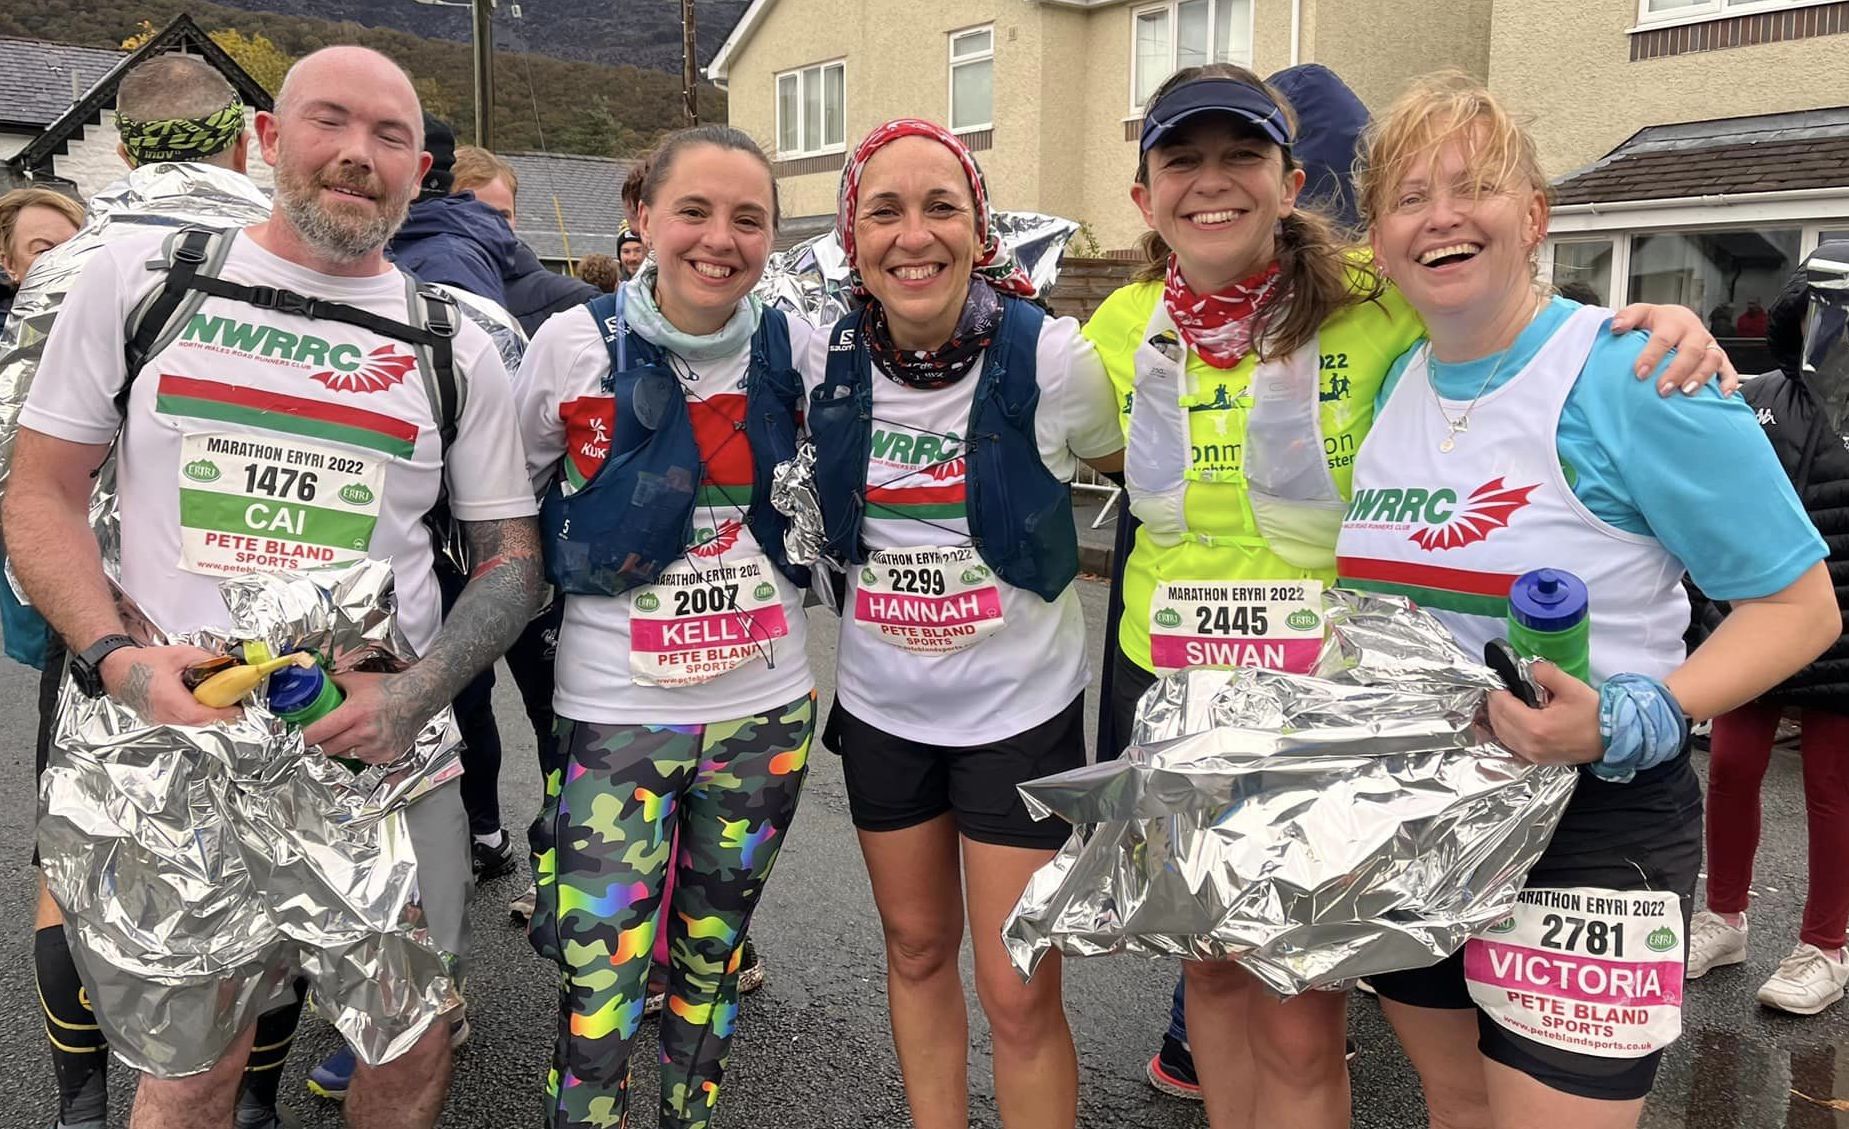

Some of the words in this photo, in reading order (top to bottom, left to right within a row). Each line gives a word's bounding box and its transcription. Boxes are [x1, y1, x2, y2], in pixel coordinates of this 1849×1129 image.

[181, 314, 361, 372] NWRRC
[205, 344, 229, 354] WALES
[232, 350, 253, 359] ROAD
[254, 355, 290, 367] RUNNERS
[291, 362, 312, 370] CLUB
[207, 438, 283, 462] MARATHON
[286, 449, 325, 469] ERYRI
[329, 457, 364, 475] 2022
[872, 430, 960, 464] WRRC
[245, 463, 318, 501] 1476
[244, 503, 306, 535] CAI
[205, 532, 258, 551] PETE
[265, 540, 334, 561] BLAND
[235, 552, 298, 569] SPORTS
[874, 551, 913, 565] ATHON
[889, 568, 945, 596] 2299
[1168, 586, 1228, 601] MARATHON
[1232, 587, 1266, 601] ERYRI
[1270, 587, 1305, 601] 2022
[674, 584, 739, 616] 2007
[869, 594, 980, 623] HANNAH
[662, 615, 755, 646] KELLY
[881, 625, 918, 637] PETE
[922, 625, 976, 638] BLAND
[1196, 606, 1268, 635] 2445
[906, 638, 952, 646] SPORTS
[1186, 641, 1284, 668] SIWAN
[658, 651, 700, 665] PETE
[686, 661, 736, 673] SPORTS
[1517, 890, 1580, 911] ARATHON
[1586, 897, 1628, 916] ERYRI
[1633, 900, 1665, 917] 2022
[1540, 914, 1624, 958] 2781
[1488, 949, 1662, 998] VICTORIA
[1507, 991, 1565, 1016] PETE
[1574, 1004, 1649, 1025] BLAND
[1504, 1015, 1652, 1051] www.peteblandsports.co.uk
[1542, 1016, 1614, 1037] SPORTS
